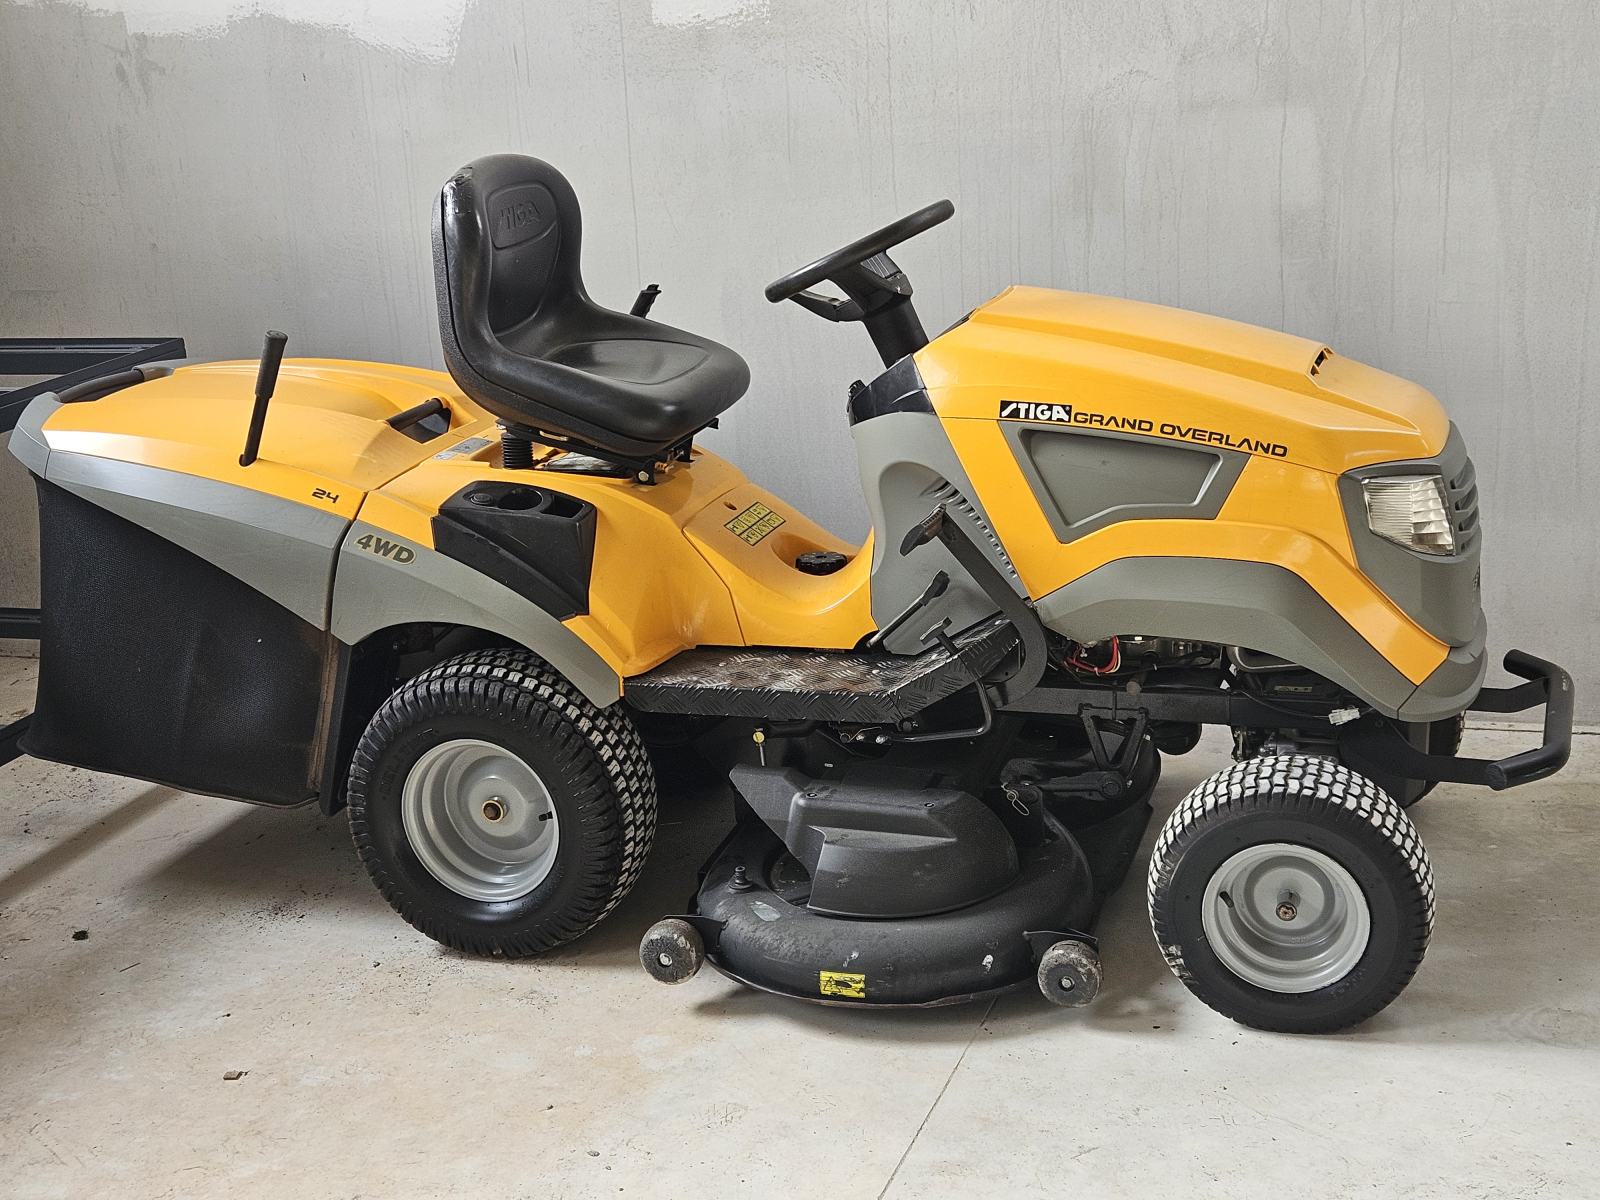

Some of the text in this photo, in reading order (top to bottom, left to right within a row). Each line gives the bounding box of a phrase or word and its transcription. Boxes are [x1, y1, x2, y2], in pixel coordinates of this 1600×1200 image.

[1001, 402, 1288, 458] STIGA GRAND OVERLAND
[311, 487, 339, 504] 24
[356, 534, 415, 564] 4WD
